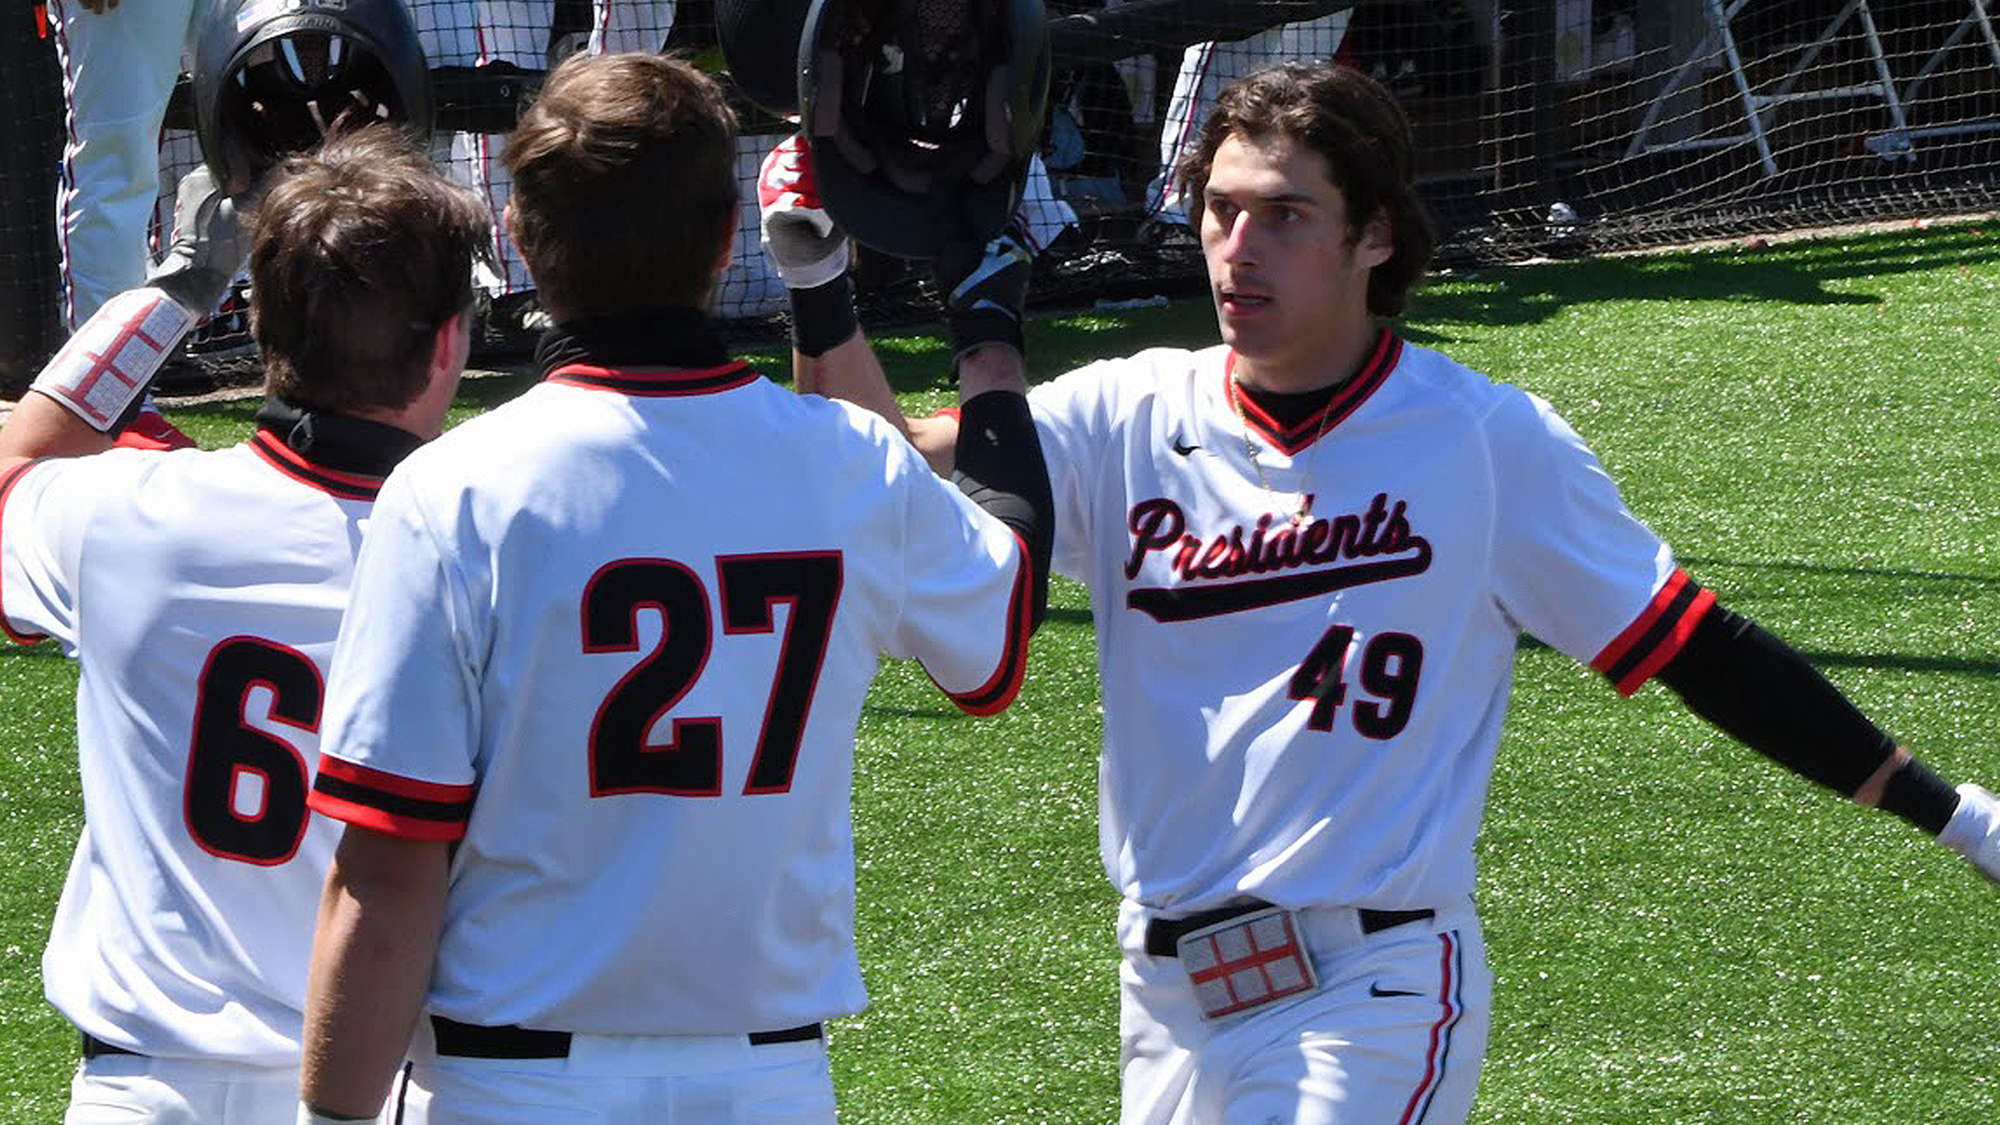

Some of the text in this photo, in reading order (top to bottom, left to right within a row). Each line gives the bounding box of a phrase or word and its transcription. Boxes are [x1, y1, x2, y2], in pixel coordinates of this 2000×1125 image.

[1124, 492, 1414, 581] Presidents
[184, 635, 325, 867] 6
[581, 549, 844, 798] 27
[1287, 624, 1424, 740] 49
